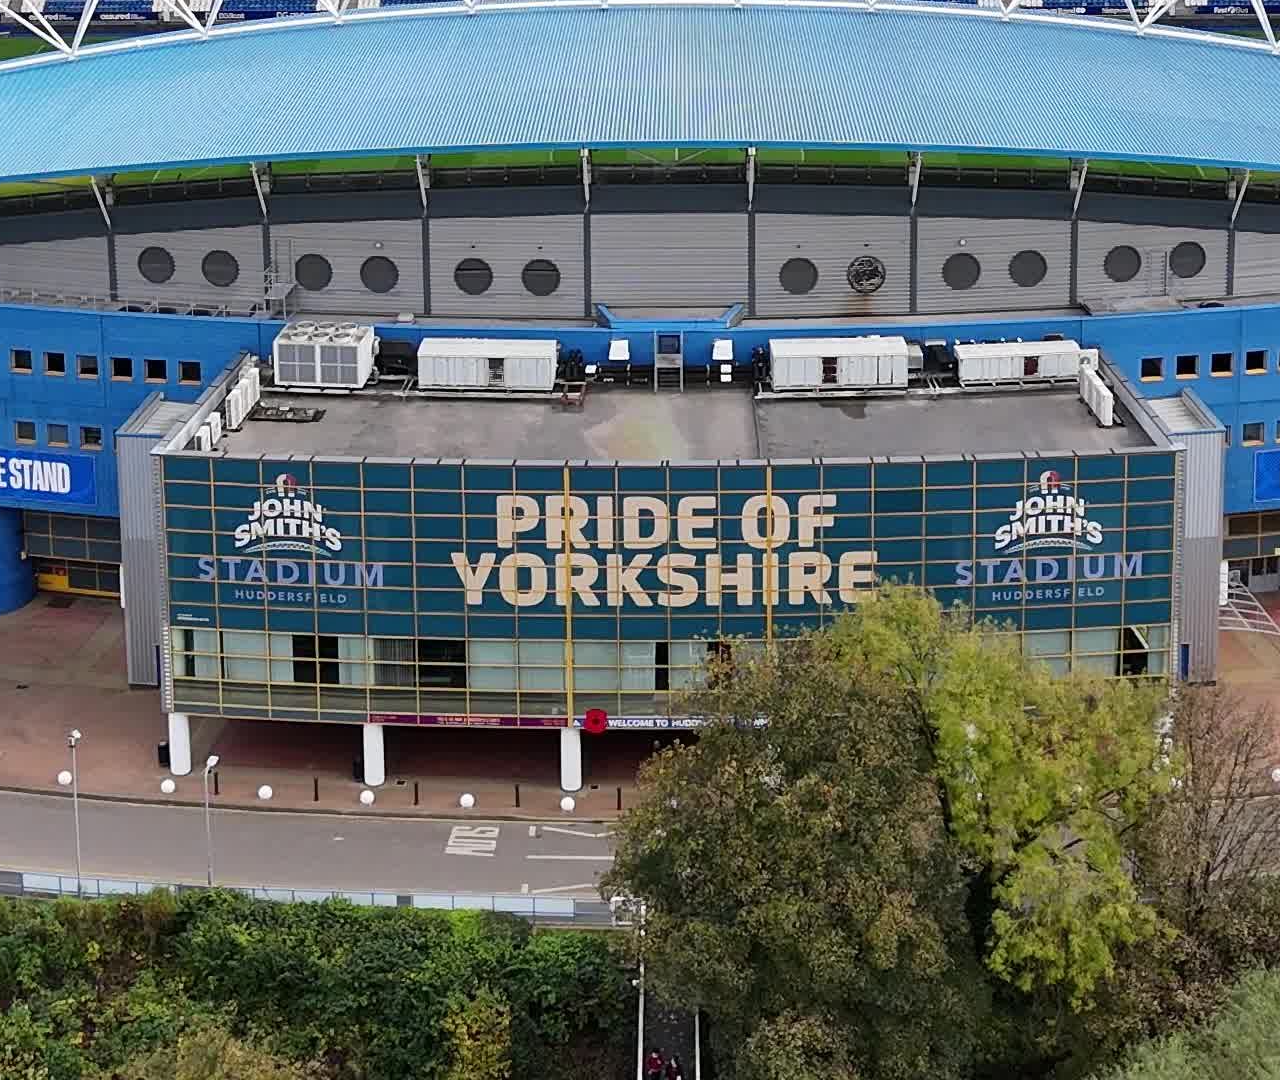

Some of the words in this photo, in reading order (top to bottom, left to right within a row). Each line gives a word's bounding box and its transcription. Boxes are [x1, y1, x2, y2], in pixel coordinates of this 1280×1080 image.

[8, 457, 70, 494] STAND
[247, 498, 323, 522] JOHN
[496, 495, 717, 549] PRIDE
[741, 494, 838, 549] OF
[1010, 495, 1085, 521] JOHN
[233, 517, 343, 552] SMITH'S
[994, 514, 1104, 550] SMITH'S
[197, 557, 385, 588] STADIUM
[450, 550, 879, 607] YORKSHIRE
[955, 552, 1143, 586] STADIUM
[234, 589, 347, 605] HUDDERSFELD
[991, 586, 1105, 601] HUDDERSFELD
[607, 719, 654, 728] WELCOME
[655, 719, 669, 728] TO
